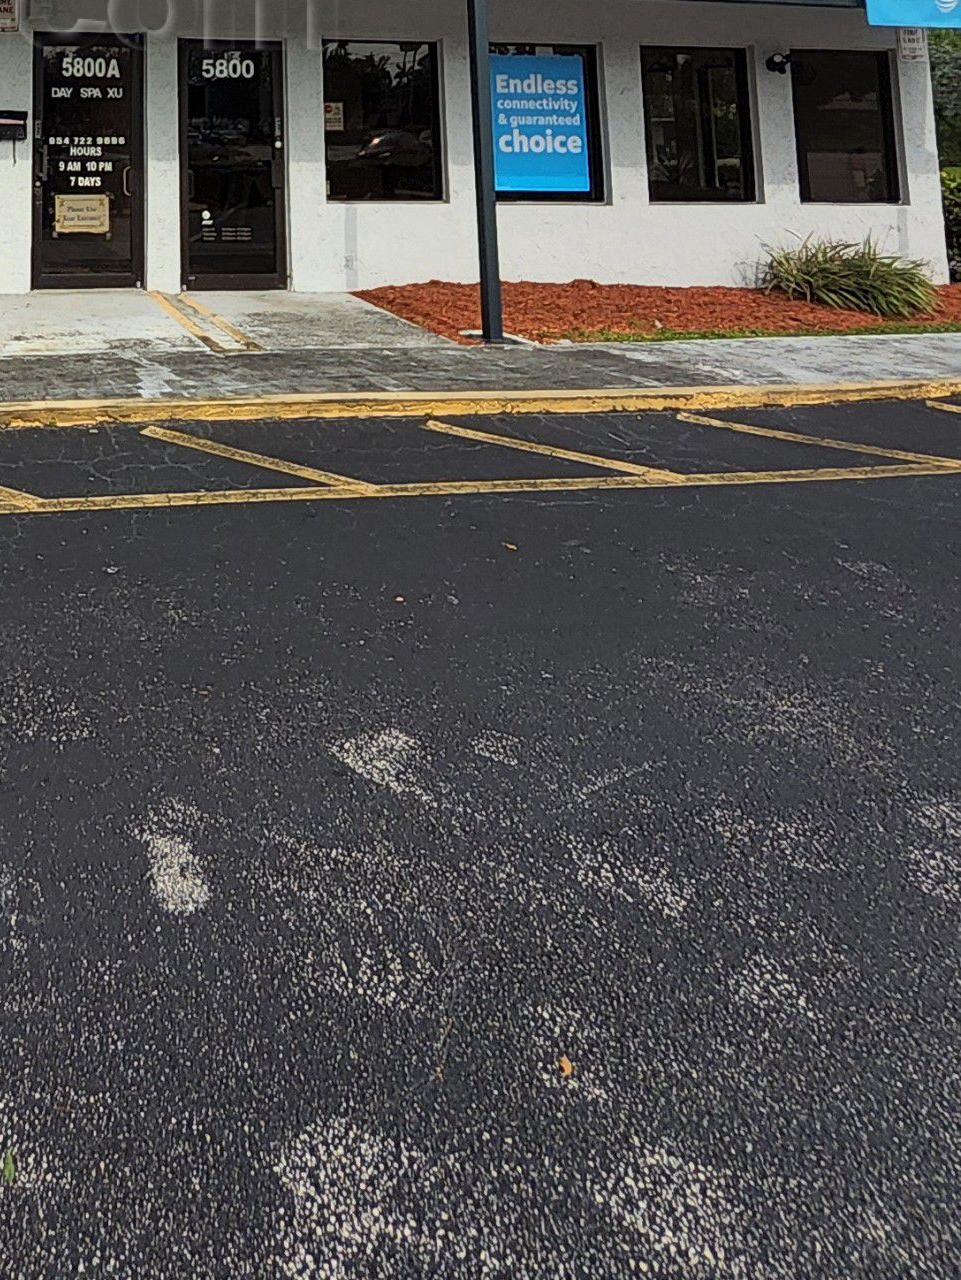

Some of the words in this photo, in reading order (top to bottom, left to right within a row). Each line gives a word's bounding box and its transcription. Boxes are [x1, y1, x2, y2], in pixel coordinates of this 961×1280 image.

[62, 57, 121, 78] 5800A
[201, 59, 255, 79] 5800
[495, 74, 579, 95] Endless
[51, 87, 73, 98] DAY
[80, 87, 103, 98] SPA
[106, 87, 123, 99] XU
[497, 97, 578, 113] connectivity
[498, 113, 508, 125] &
[509, 113, 581, 128] guaranteed
[73, 136, 93, 145] 722
[498, 128, 583, 154] choice
[69, 146, 103, 157] HOURS
[58, 161, 65, 172] 9
[66, 161, 81, 172] AM
[85, 161, 97, 171] 10
[98, 161, 113, 172] PM
[69, 176, 76, 187] 7
[77, 176, 102, 187] DAYS
